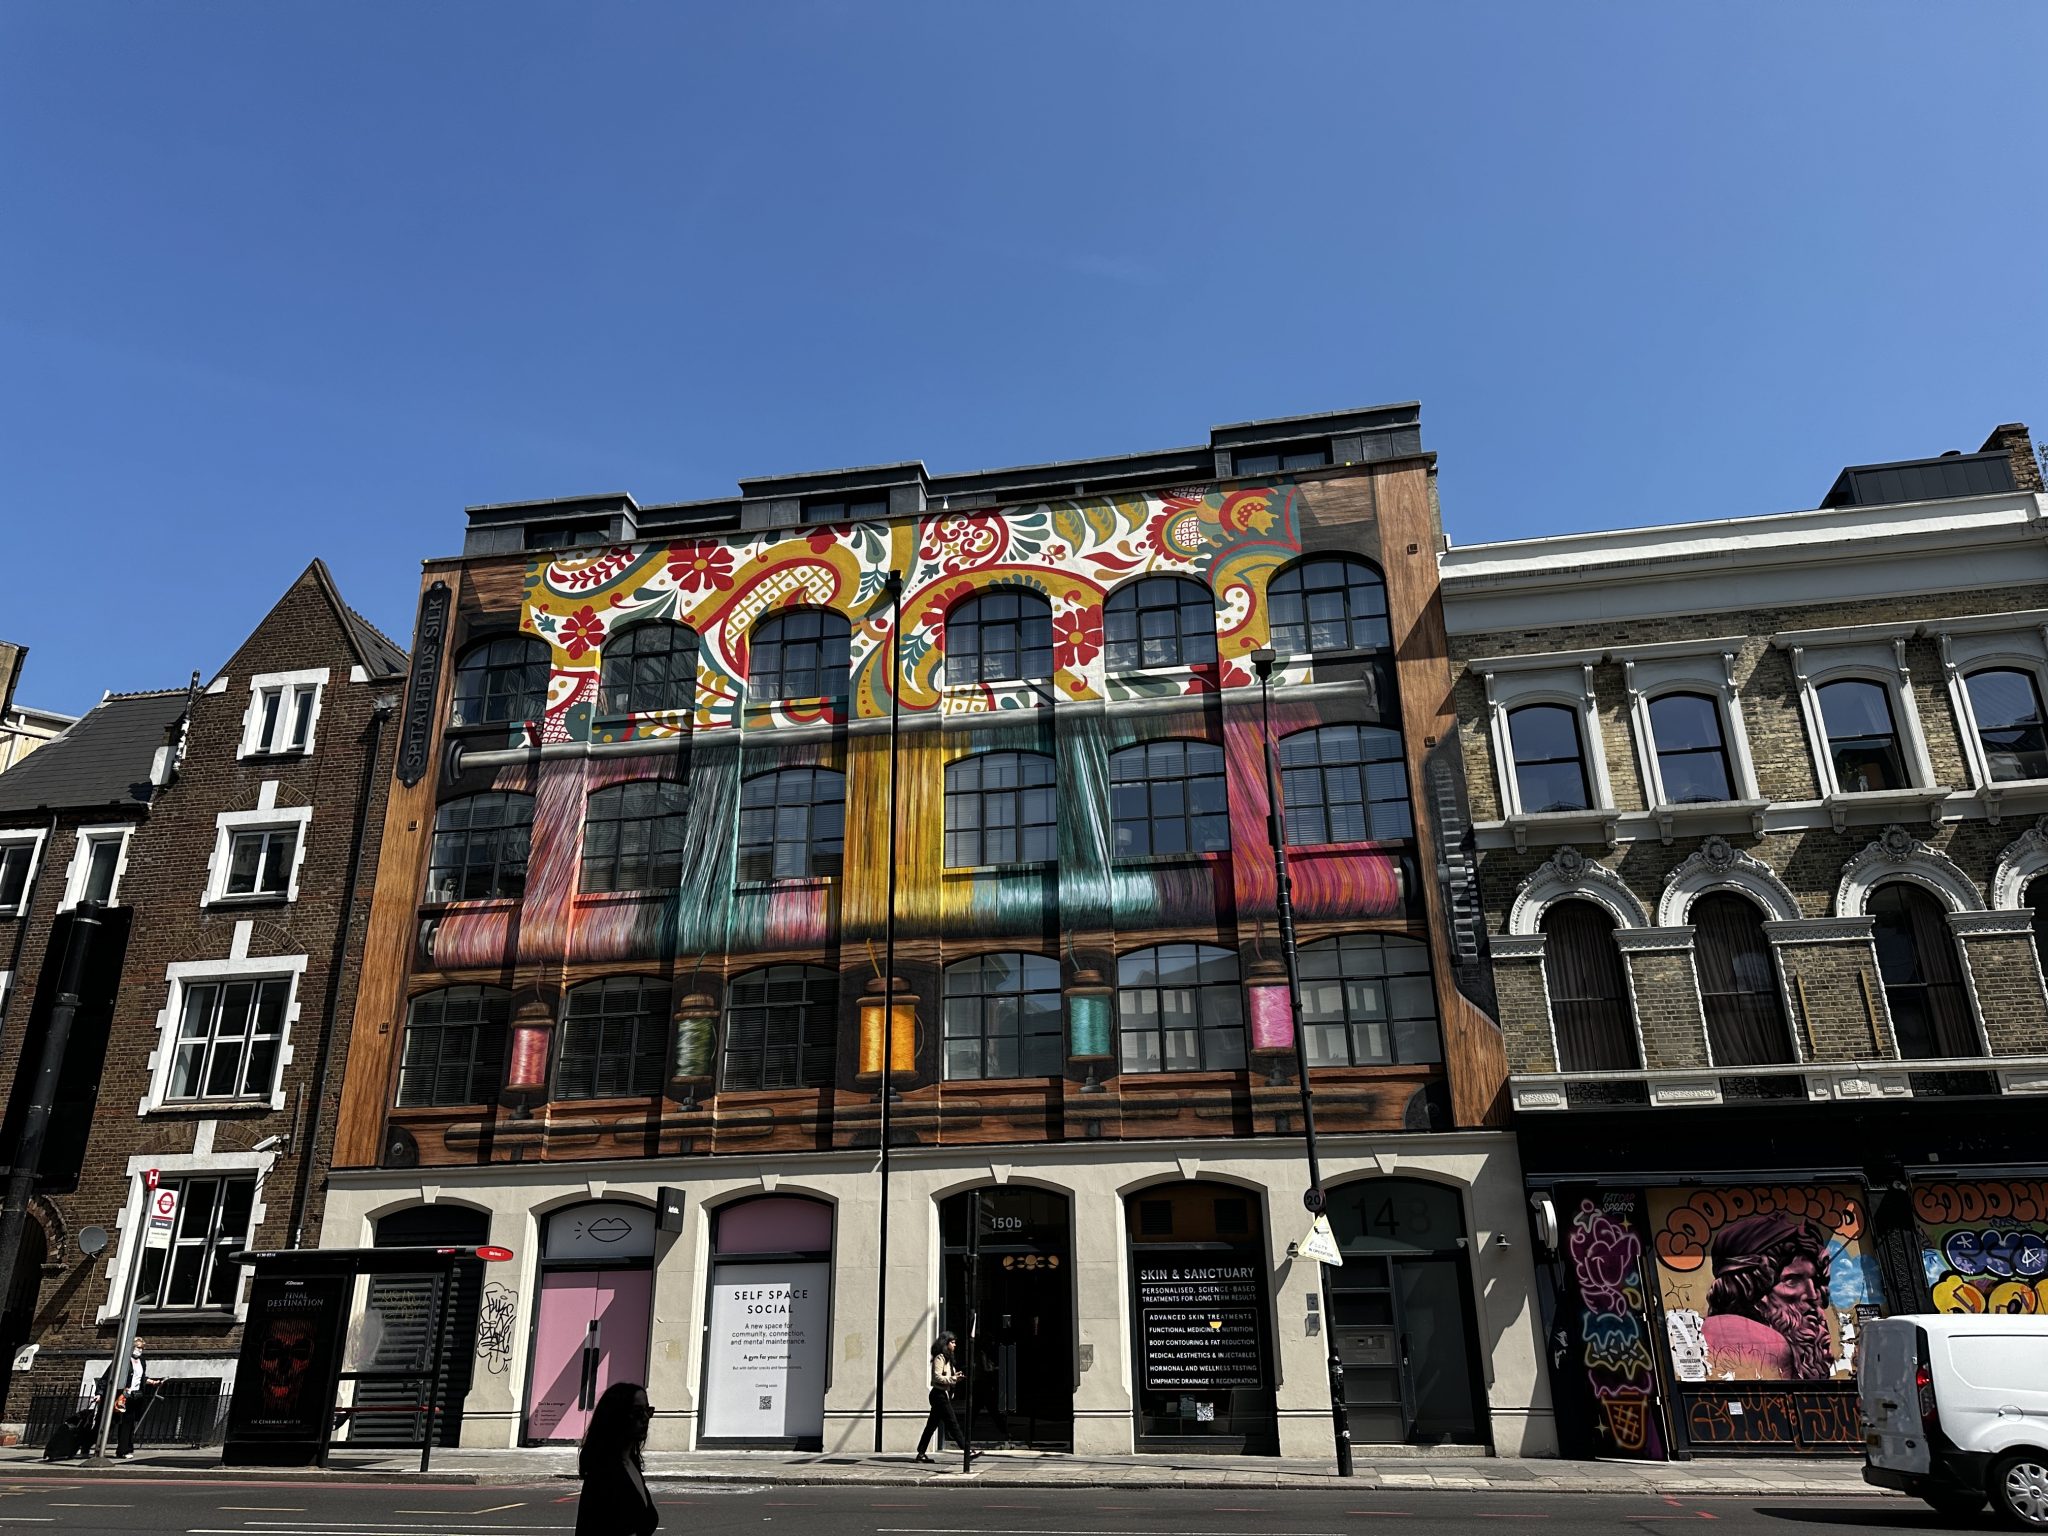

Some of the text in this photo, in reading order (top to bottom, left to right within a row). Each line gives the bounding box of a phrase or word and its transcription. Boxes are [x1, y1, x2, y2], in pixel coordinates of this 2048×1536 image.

[407, 598, 443, 767] SPITALFIELDS SILK
[148, 1171, 160, 1185] H
[1307, 1195, 1320, 1205] 20
[1602, 1203, 1635, 1213] SPRAYS
[1351, 1196, 1433, 1236] 148
[991, 1216, 1022, 1229] 150b
[1140, 1267, 1255, 1280] SKIN & SANCTUARY
[1198, 1285, 1256, 1293] SCIENCE-BASED
[284, 1291, 308, 1299] FINAL
[734, 1289, 808, 1300] SELF SPACE
[1142, 1295, 1180, 1303] TREATMENTS
[1194, 1294, 1212, 1302] LONG
[267, 1298, 324, 1307] DESTINATION
[747, 1304, 794, 1314] SOCIAL
[764, 1323, 783, 1331] space
[1149, 1326, 1186, 1334] FUNCTIONAL
[1187, 1326, 1215, 1334] MEDICINE
[731, 1331, 768, 1339] community,
[743, 1337, 765, 1345] mental
[1231, 1364, 1257, 1372] TESTING
[1150, 1378, 1180, 1386] LYMPHATIC
